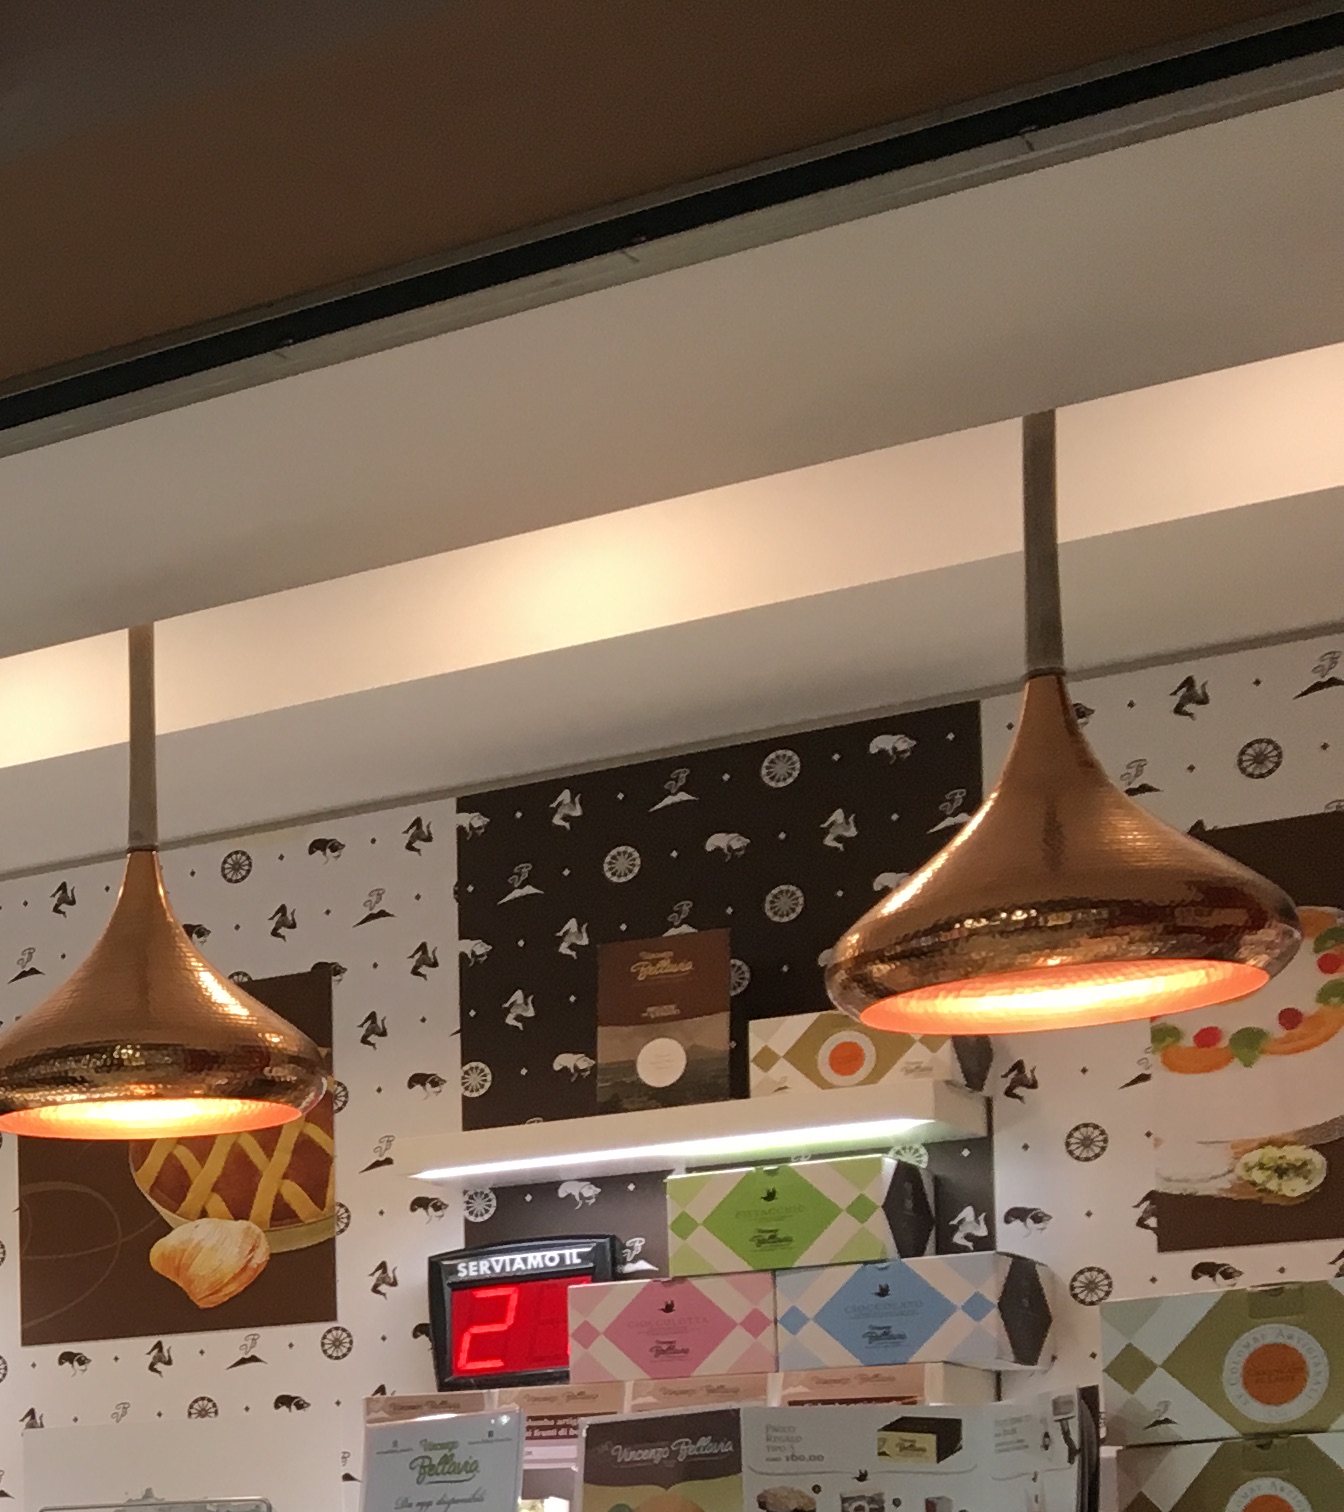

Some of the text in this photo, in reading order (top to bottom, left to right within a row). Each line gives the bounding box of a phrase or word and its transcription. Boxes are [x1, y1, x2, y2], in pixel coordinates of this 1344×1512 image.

[457, 1253, 559, 1277] SERVIAMO
[458, 1287, 518, 1371] 2
[612, 1436, 734, 1464] Vincenzo Bellavia
[409, 1453, 480, 1484] Bellavia
